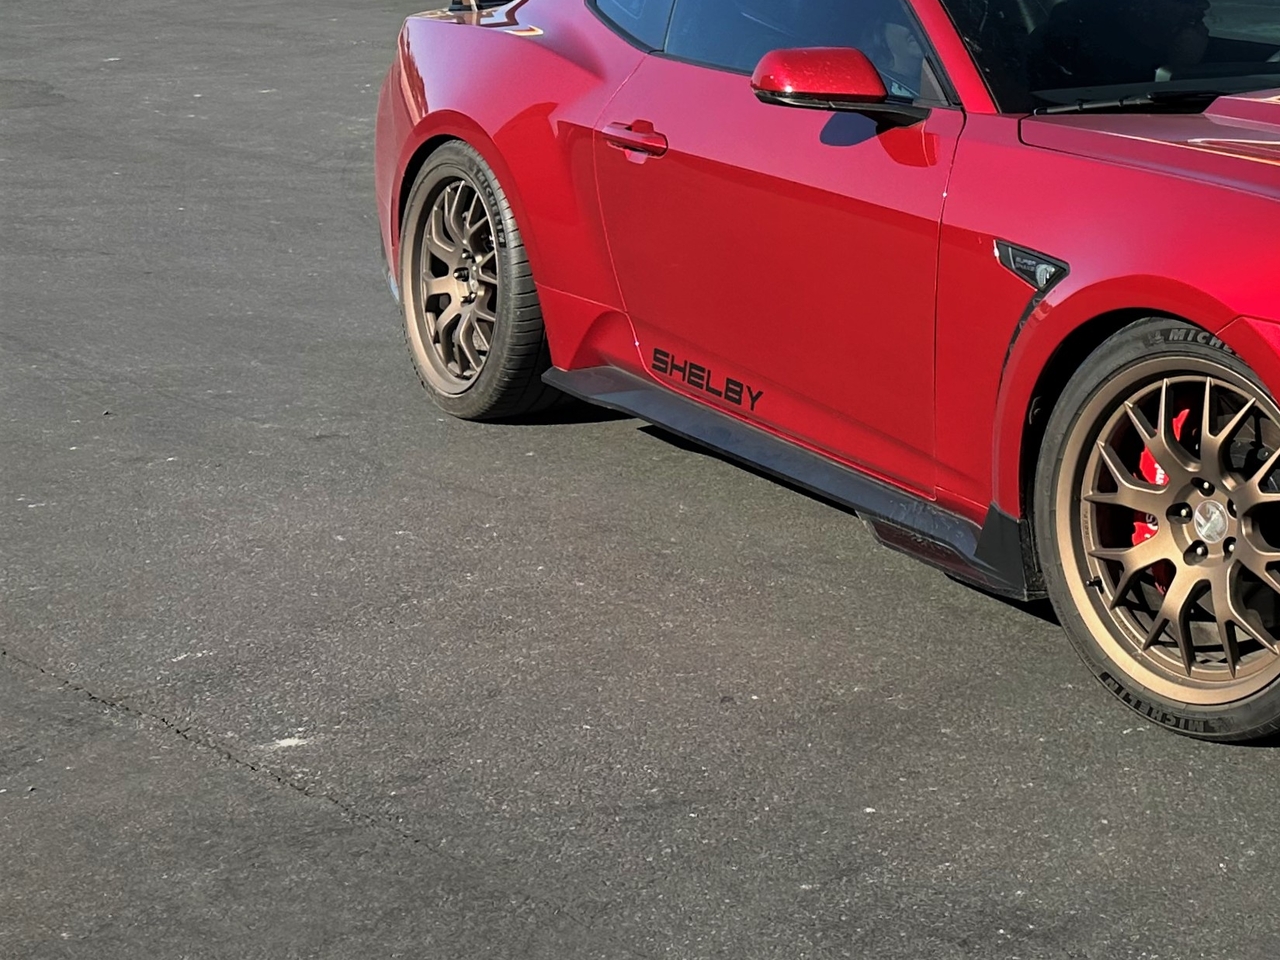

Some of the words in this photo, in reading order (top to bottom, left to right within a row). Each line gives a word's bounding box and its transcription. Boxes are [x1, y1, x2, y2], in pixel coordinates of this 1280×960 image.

[476, 168, 506, 244] MICHELIN
[1168, 328, 1234, 354] MICHE
[651, 347, 765, 412] SHELBY
[1105, 677, 1205, 732] MICHELIN
